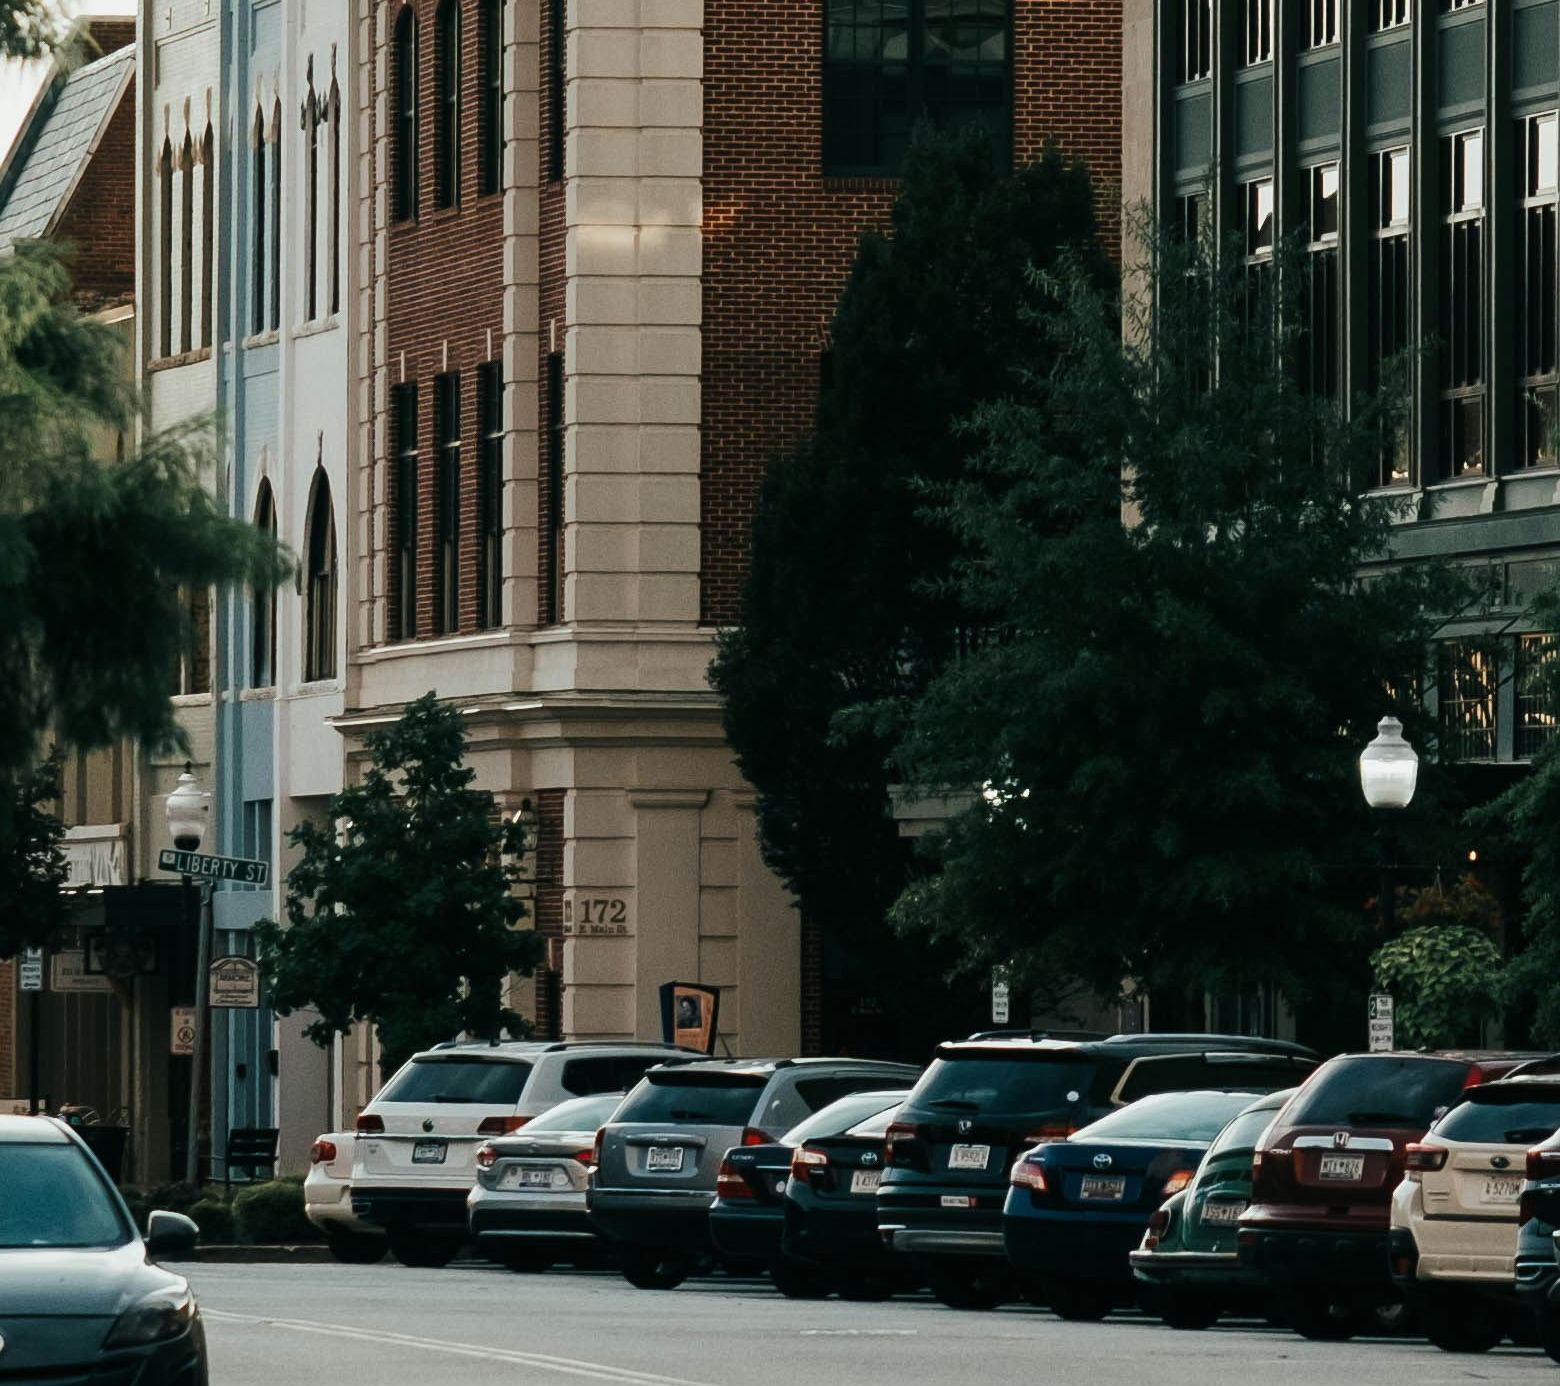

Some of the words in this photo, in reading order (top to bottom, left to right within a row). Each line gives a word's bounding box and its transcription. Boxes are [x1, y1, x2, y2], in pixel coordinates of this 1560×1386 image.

[176, 853, 239, 879] LIBERTY
[245, 864, 265, 881] ST
[580, 898, 627, 924] 172
